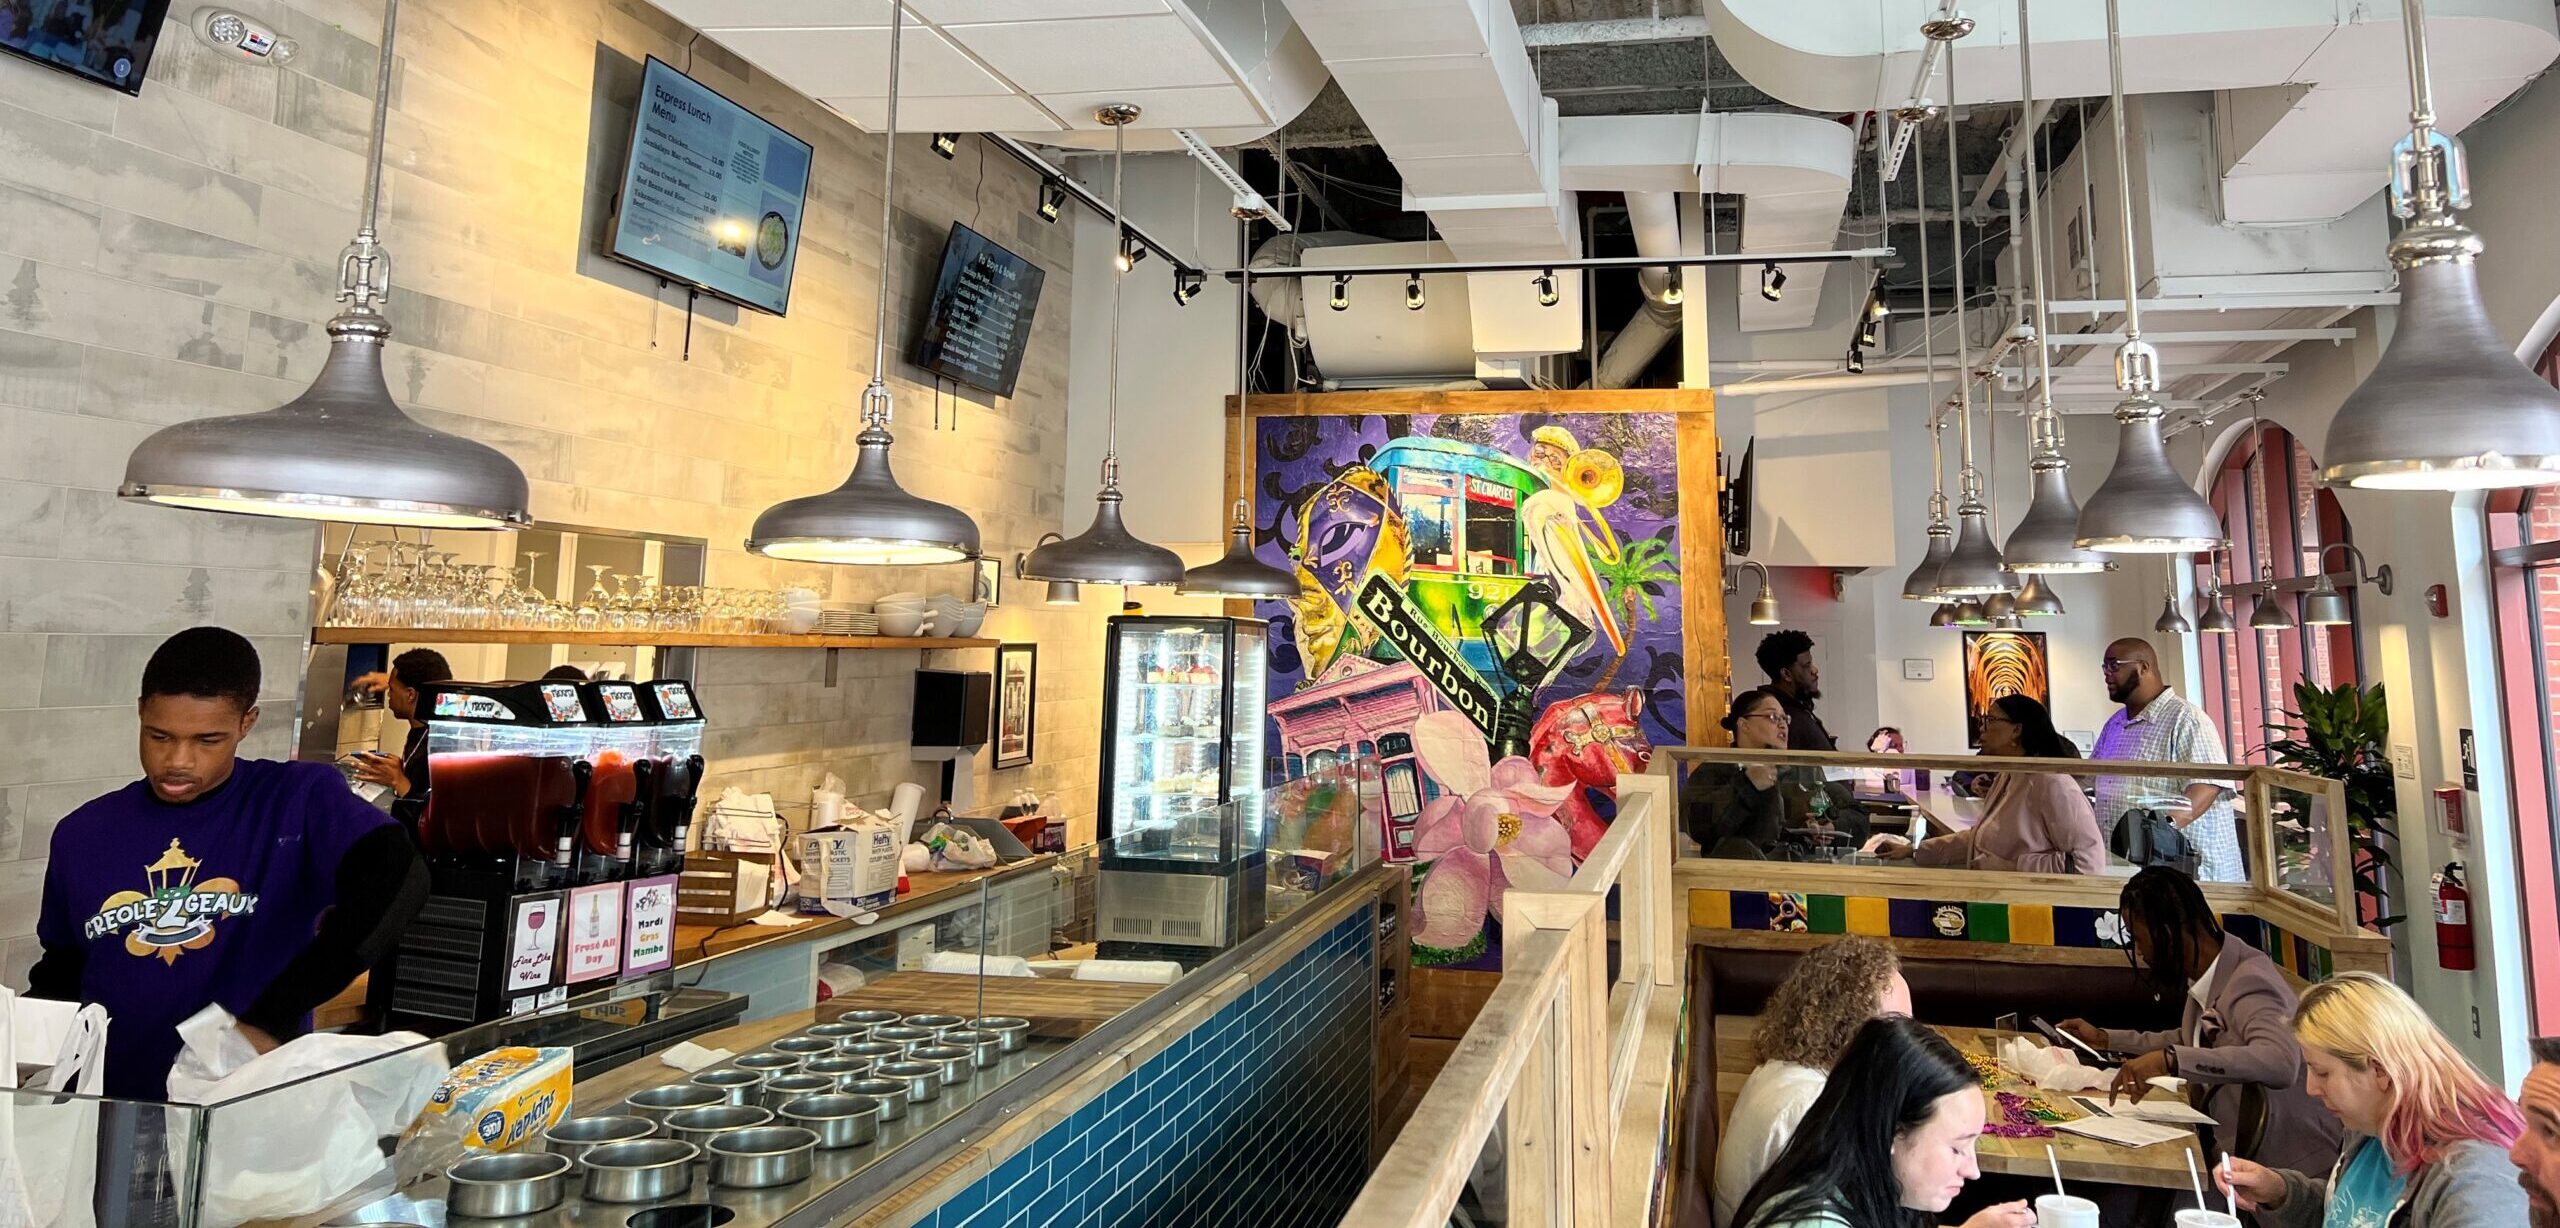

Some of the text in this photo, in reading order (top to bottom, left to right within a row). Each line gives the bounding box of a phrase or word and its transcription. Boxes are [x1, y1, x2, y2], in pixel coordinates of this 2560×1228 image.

[652, 101, 677, 123] Menu
[655, 85, 712, 125] Express Lunch
[1410, 608, 1469, 674] Rue Bourbon
[1366, 587, 1490, 730] Bourbon
[873, 832, 891, 847] Hefty
[85, 899, 159, 941] CREOLE
[185, 892, 258, 914] GEAUX
[638, 917, 663, 930] Mardi
[574, 938, 616, 954] Frosé All
[640, 933, 659, 943] Gras
[633, 944, 664, 958] Mambo
[513, 952, 551, 968] Fine Like
[585, 954, 603, 965] Day
[520, 971, 541, 981] Wine
